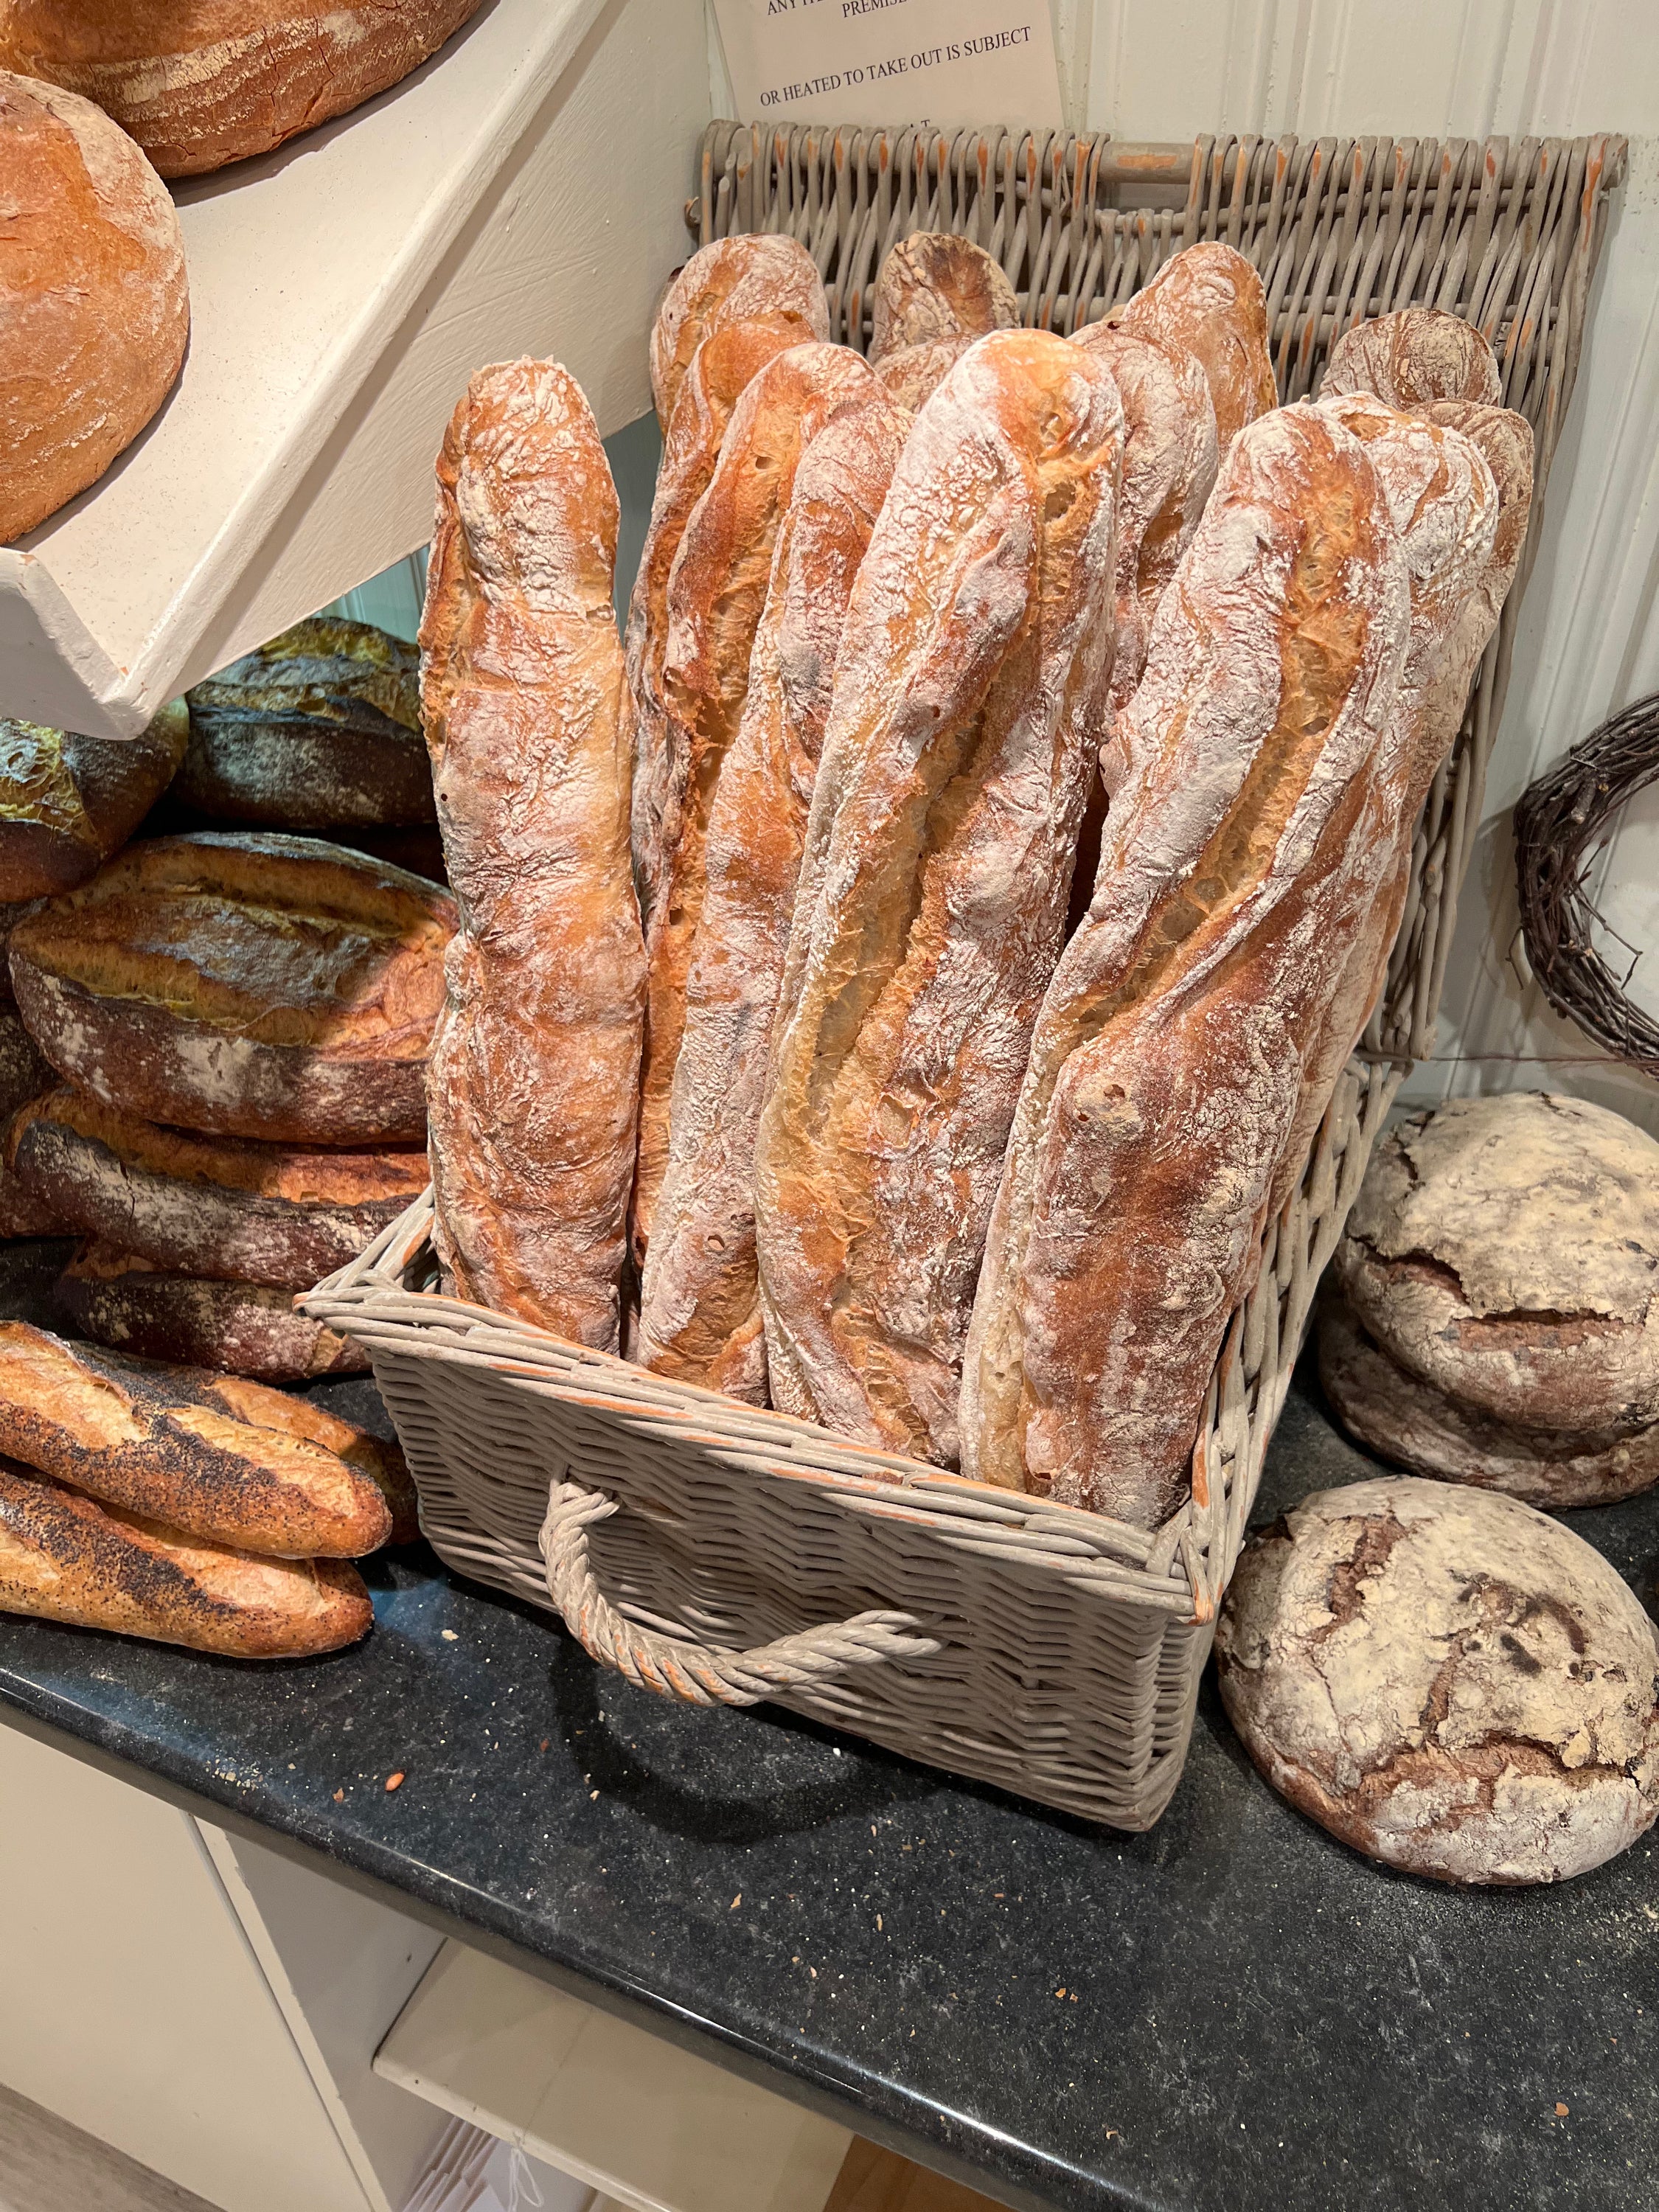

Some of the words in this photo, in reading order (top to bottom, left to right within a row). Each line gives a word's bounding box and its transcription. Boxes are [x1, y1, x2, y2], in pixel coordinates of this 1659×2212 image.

[768, 0, 796, 15] ANY
[760, 90, 781, 106] OR
[783, 74, 841, 101] HEATED
[844, 69, 864, 86] TO
[866, 58, 908, 80] TAKE
[911, 49, 942, 69] OUT
[946, 44, 960, 61] IS
[964, 27, 1031, 56] SUBJECT
